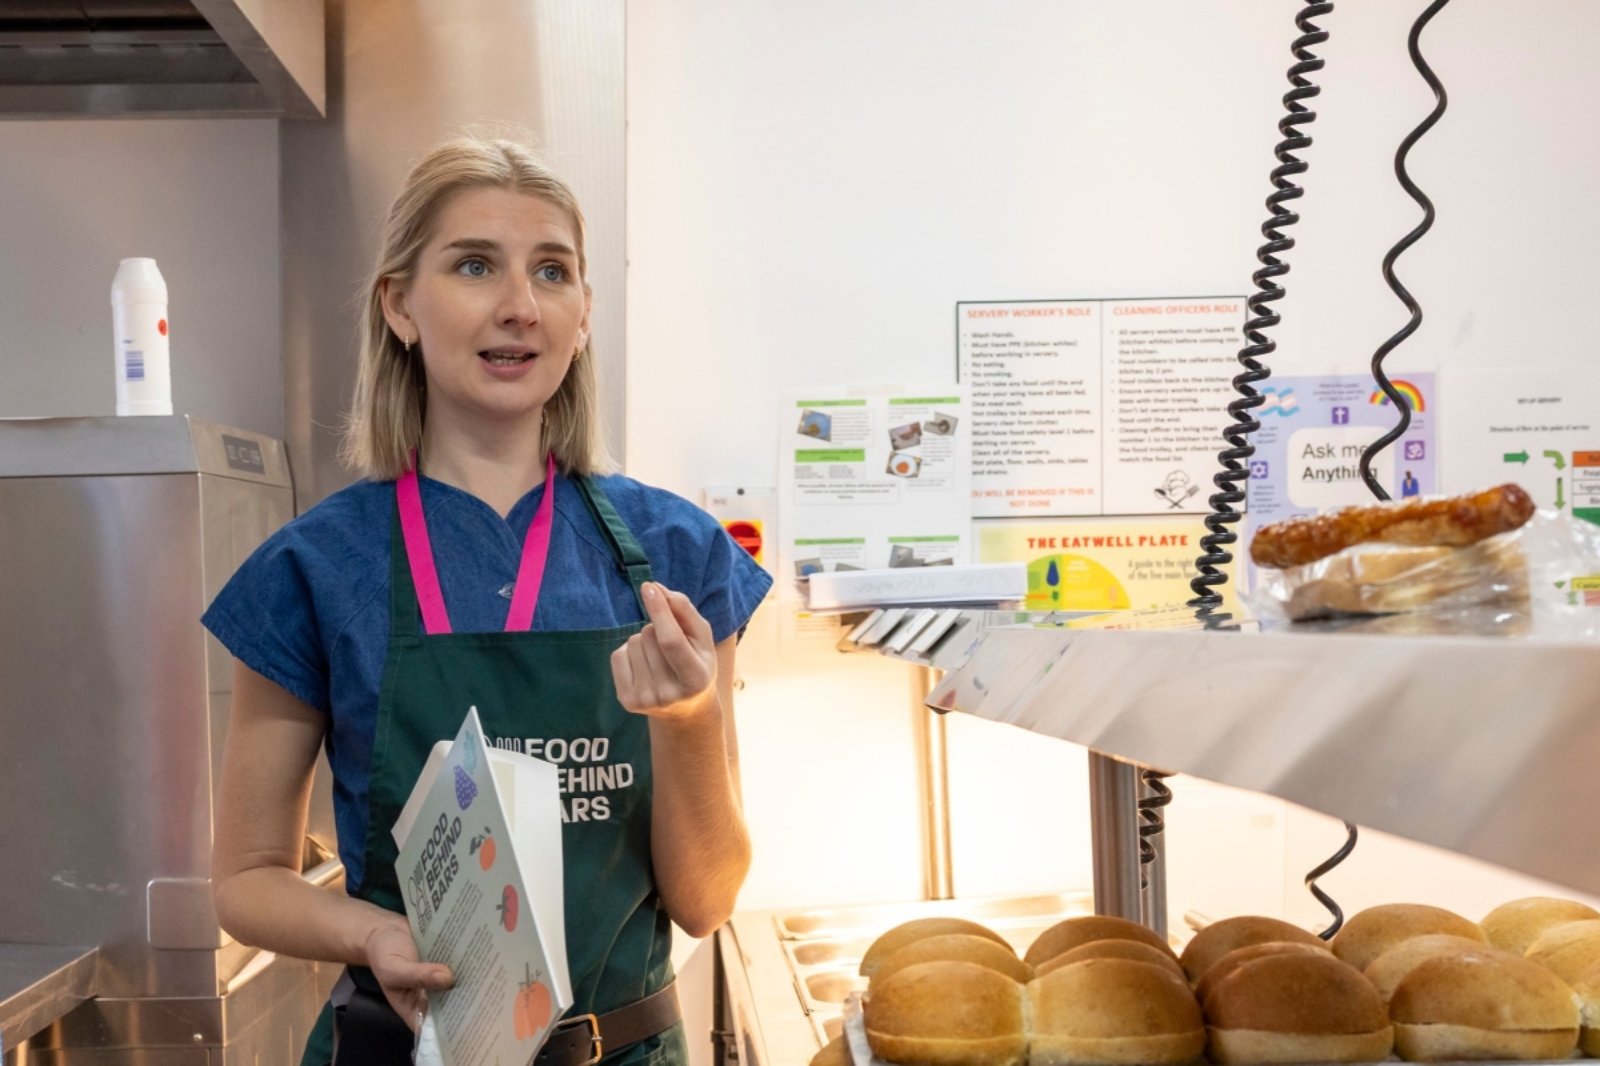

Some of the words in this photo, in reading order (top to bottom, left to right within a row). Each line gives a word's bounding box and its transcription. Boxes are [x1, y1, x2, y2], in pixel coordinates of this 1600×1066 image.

[967, 309, 1008, 318] SERVERY
[1067, 308, 1091, 316] ROLE
[1113, 306, 1162, 316] CLEANING
[1165, 305, 1211, 314] OFFICERS
[1302, 443, 1336, 459] Ask
[1027, 537, 1056, 548] THE
[1062, 535, 1133, 548] EATWELL
[1139, 535, 1189, 546] PLATE
[1164, 559, 1174, 567] the
[524, 737, 610, 763] FOOD
[558, 763, 634, 793] EHIND
[560, 796, 611, 823] RS
[421, 812, 448, 872] FOOD
[426, 816, 462, 892] BEHIND
[431, 854, 459, 912] BARS
